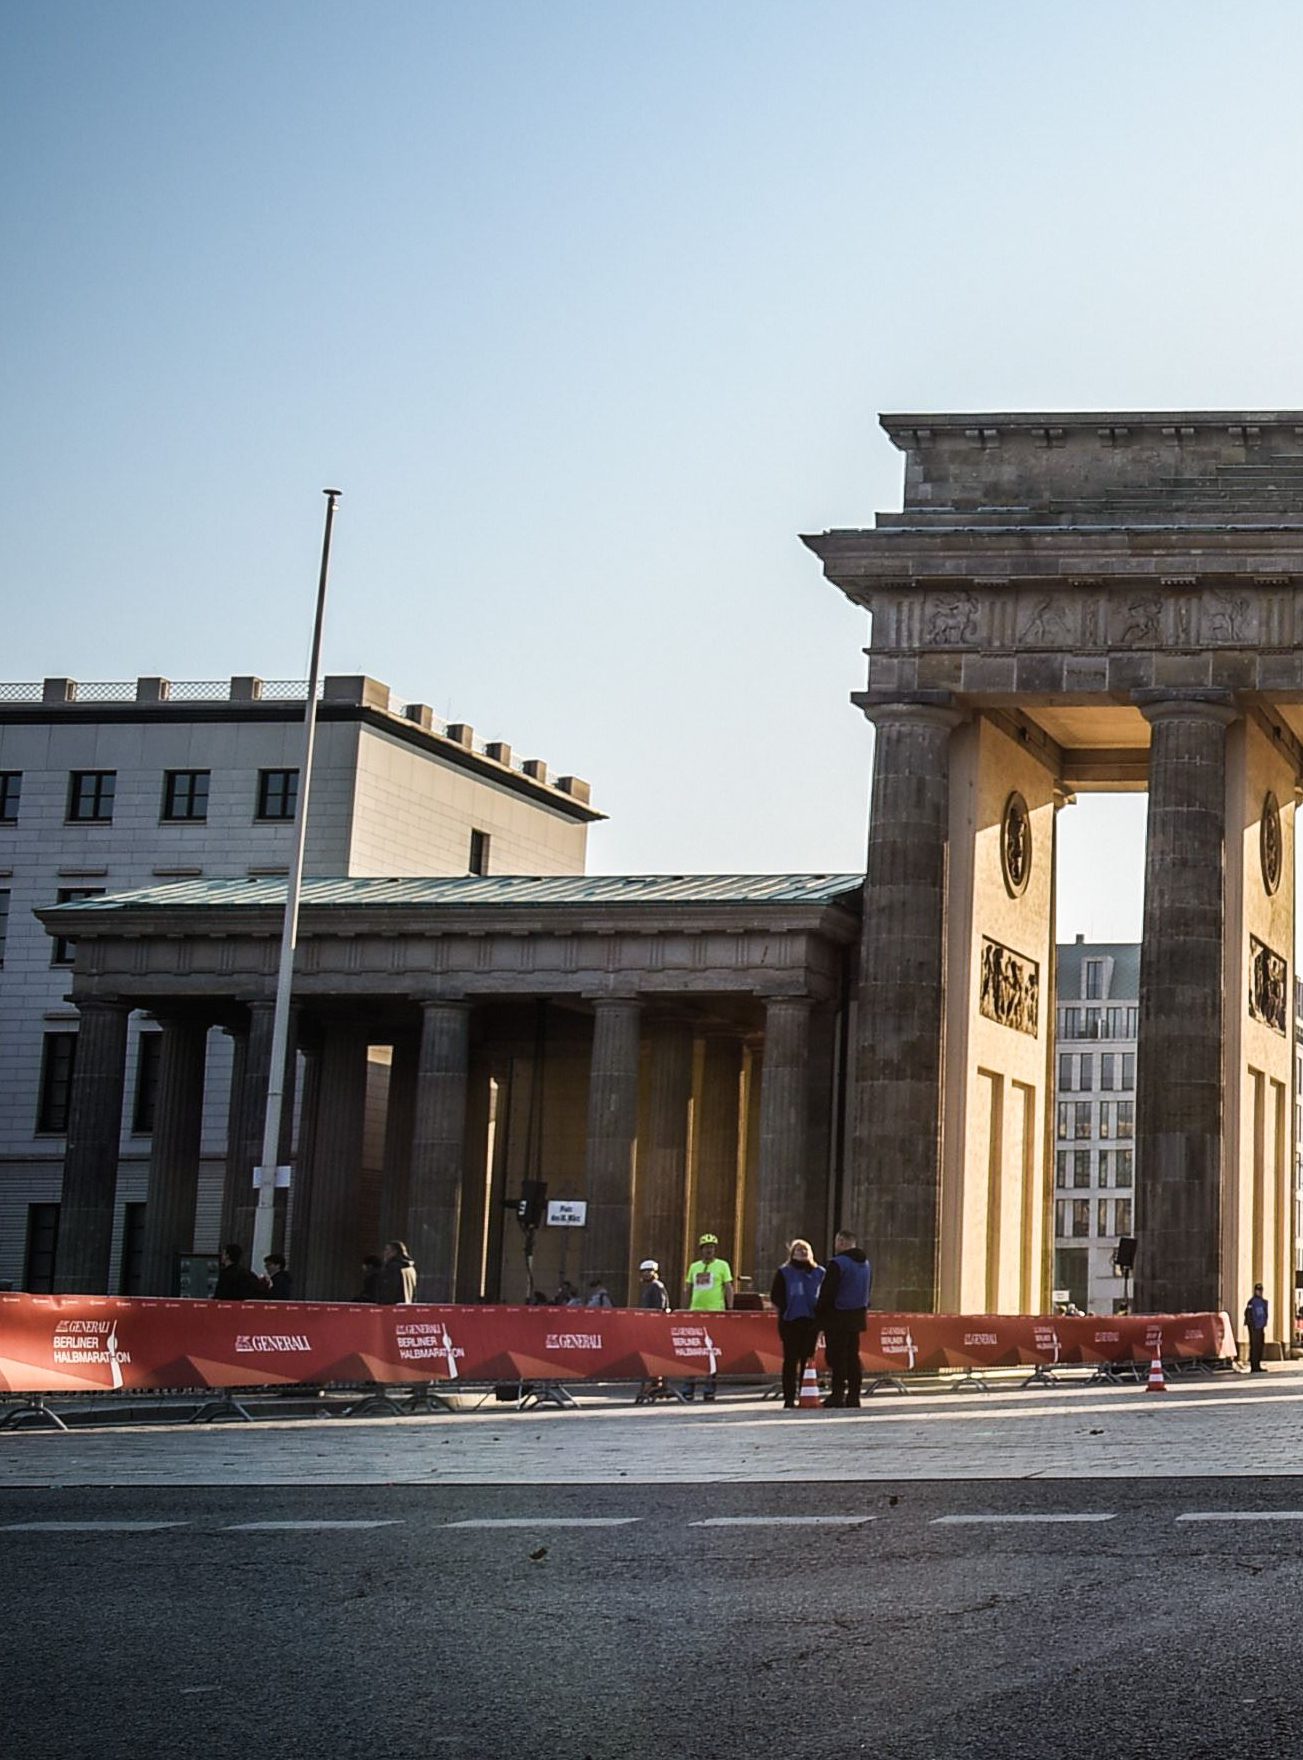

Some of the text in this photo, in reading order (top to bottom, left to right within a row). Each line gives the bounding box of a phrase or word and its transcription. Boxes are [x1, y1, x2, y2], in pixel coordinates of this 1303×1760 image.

[69, 1320, 111, 1334] GENERALI
[53, 1336, 98, 1349] BERLINER
[252, 1335, 312, 1351] GENERALI
[397, 1336, 438, 1348] BERLINER
